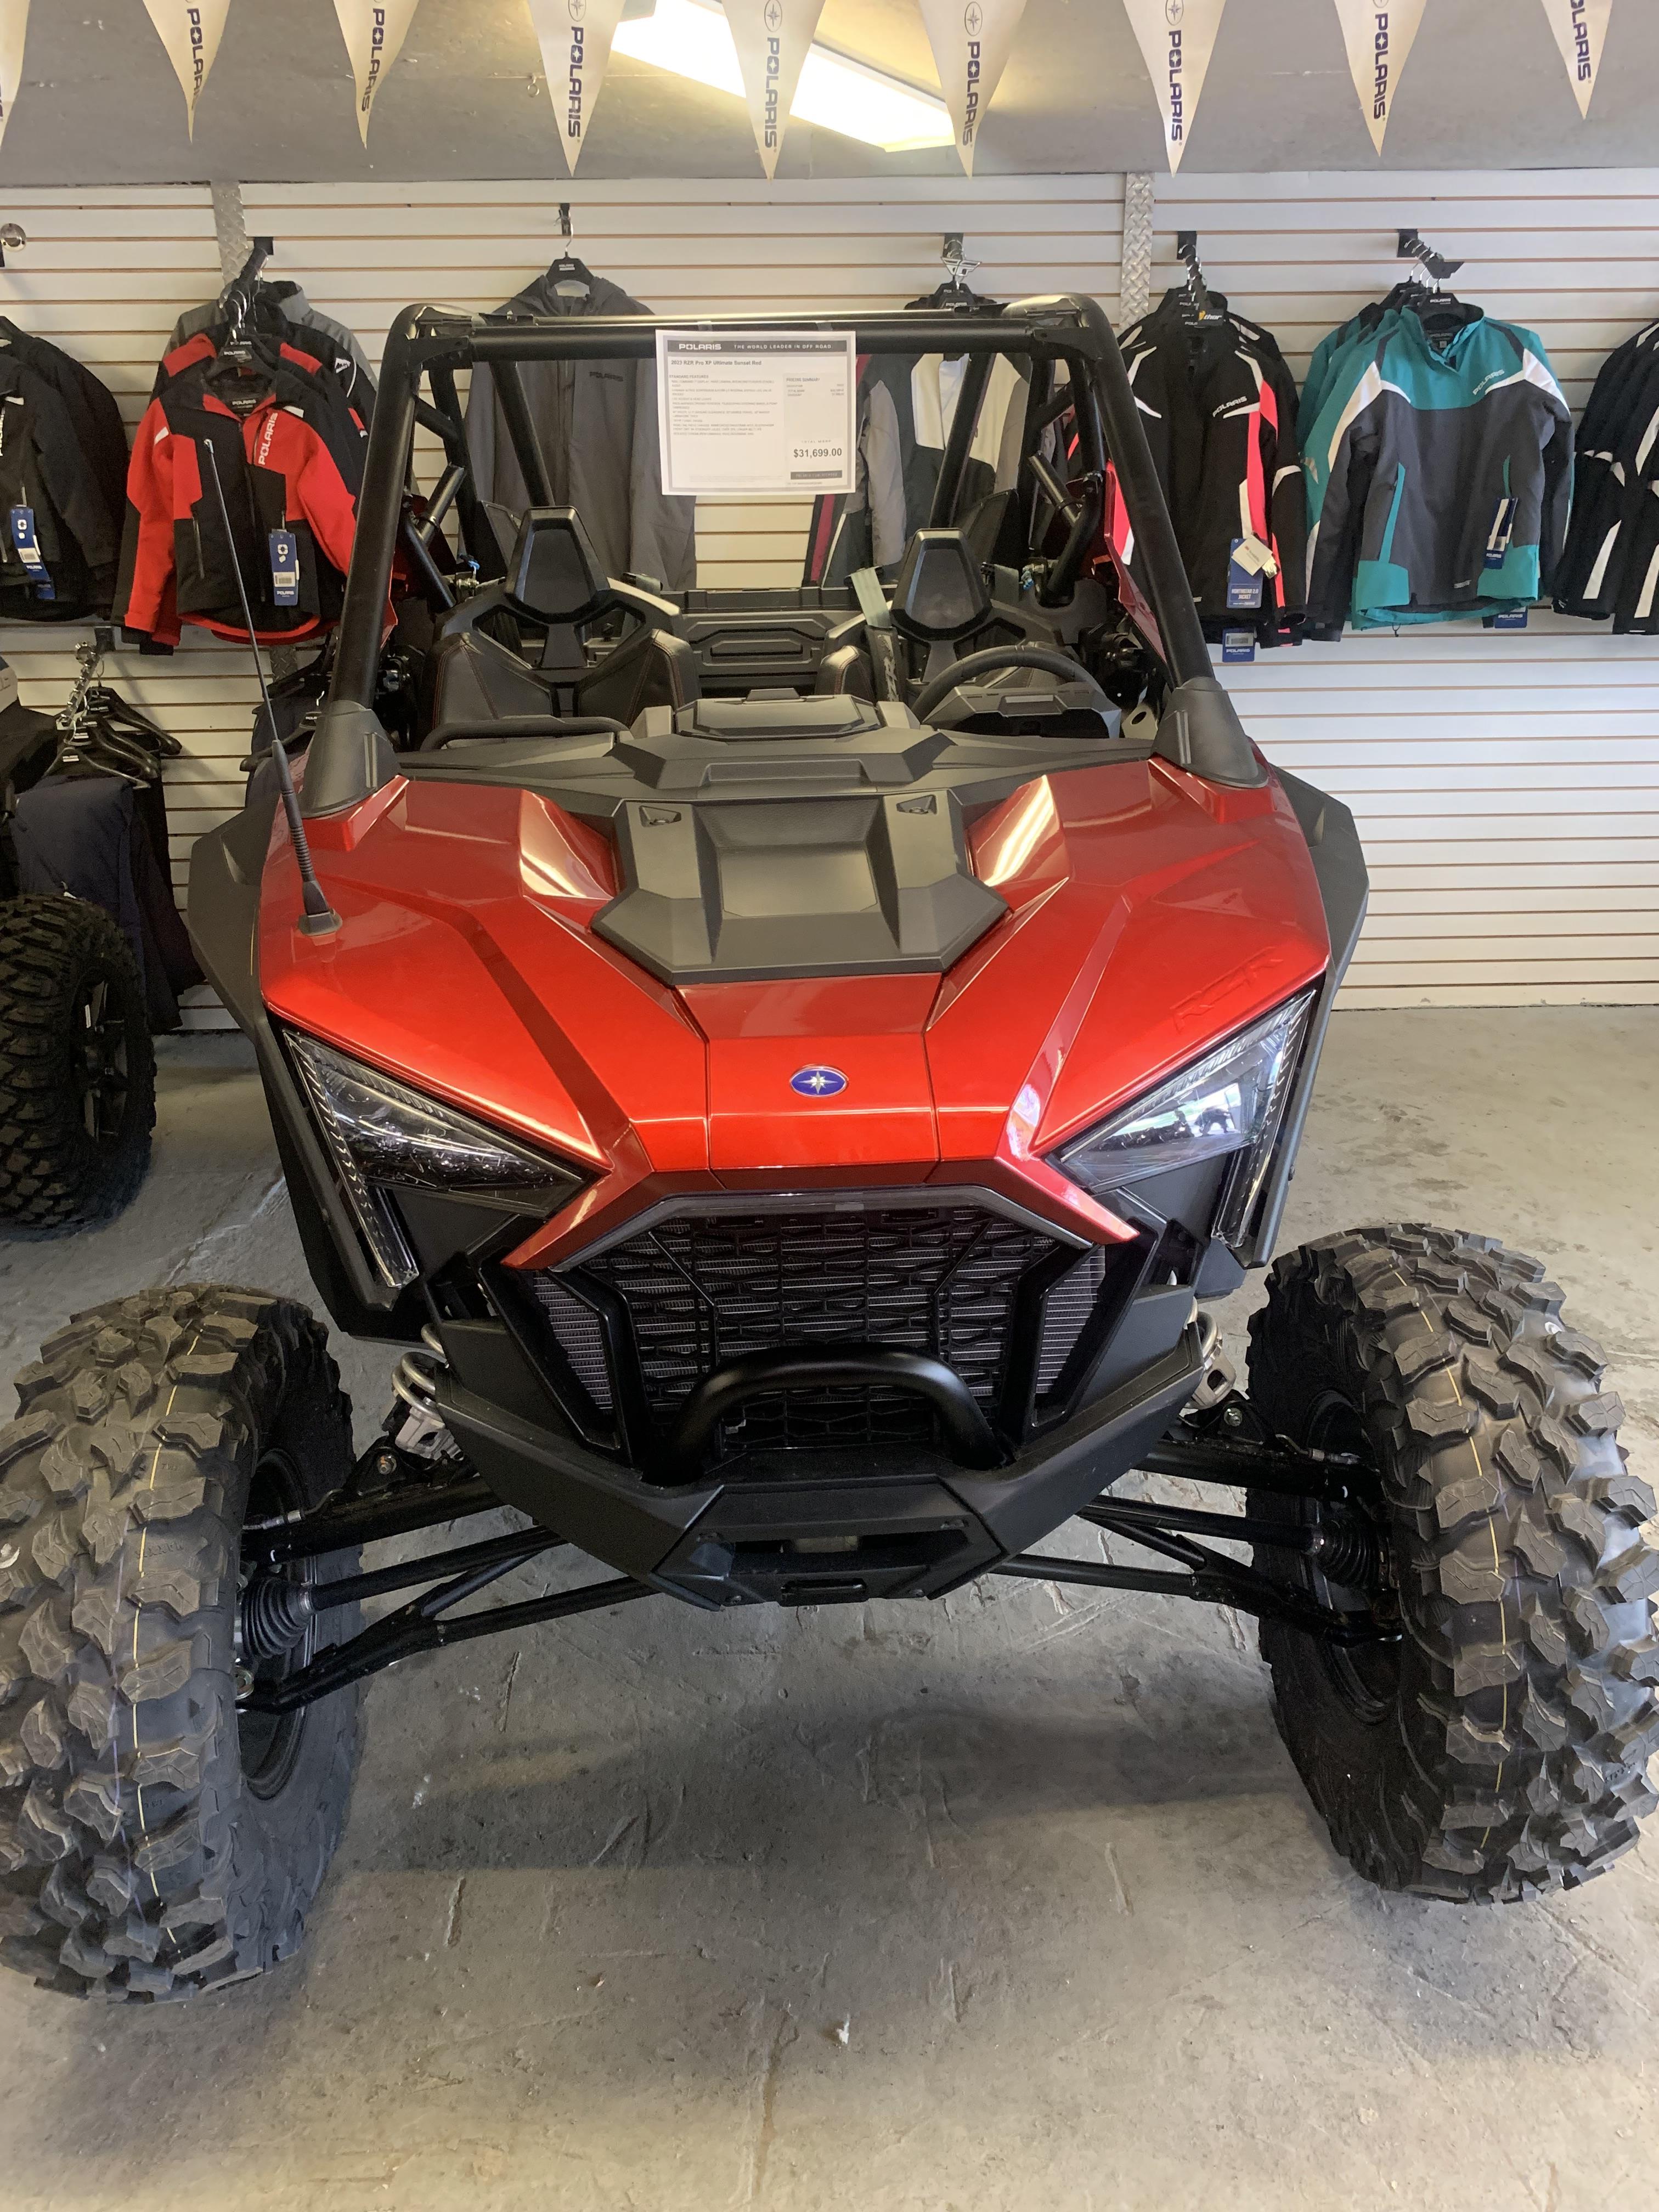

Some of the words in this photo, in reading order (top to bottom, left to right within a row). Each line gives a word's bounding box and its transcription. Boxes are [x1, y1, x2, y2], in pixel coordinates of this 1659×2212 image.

[361, 8, 385, 112] POLARIS
[568, 26, 585, 138] POLARIS
[765, 37, 780, 149] POLARIS
[962, 41, 980, 147] POLARIS
[1169, 30, 1183, 142] POLARIS
[1373, 13, 1389, 120] POLARIS
[1212, 396, 1248, 417] POLARIS
[1472, 369, 1505, 395] POLARIS
[258, 412, 279, 466] POLARIS
[793, 448, 842, 459] $31,699.00
